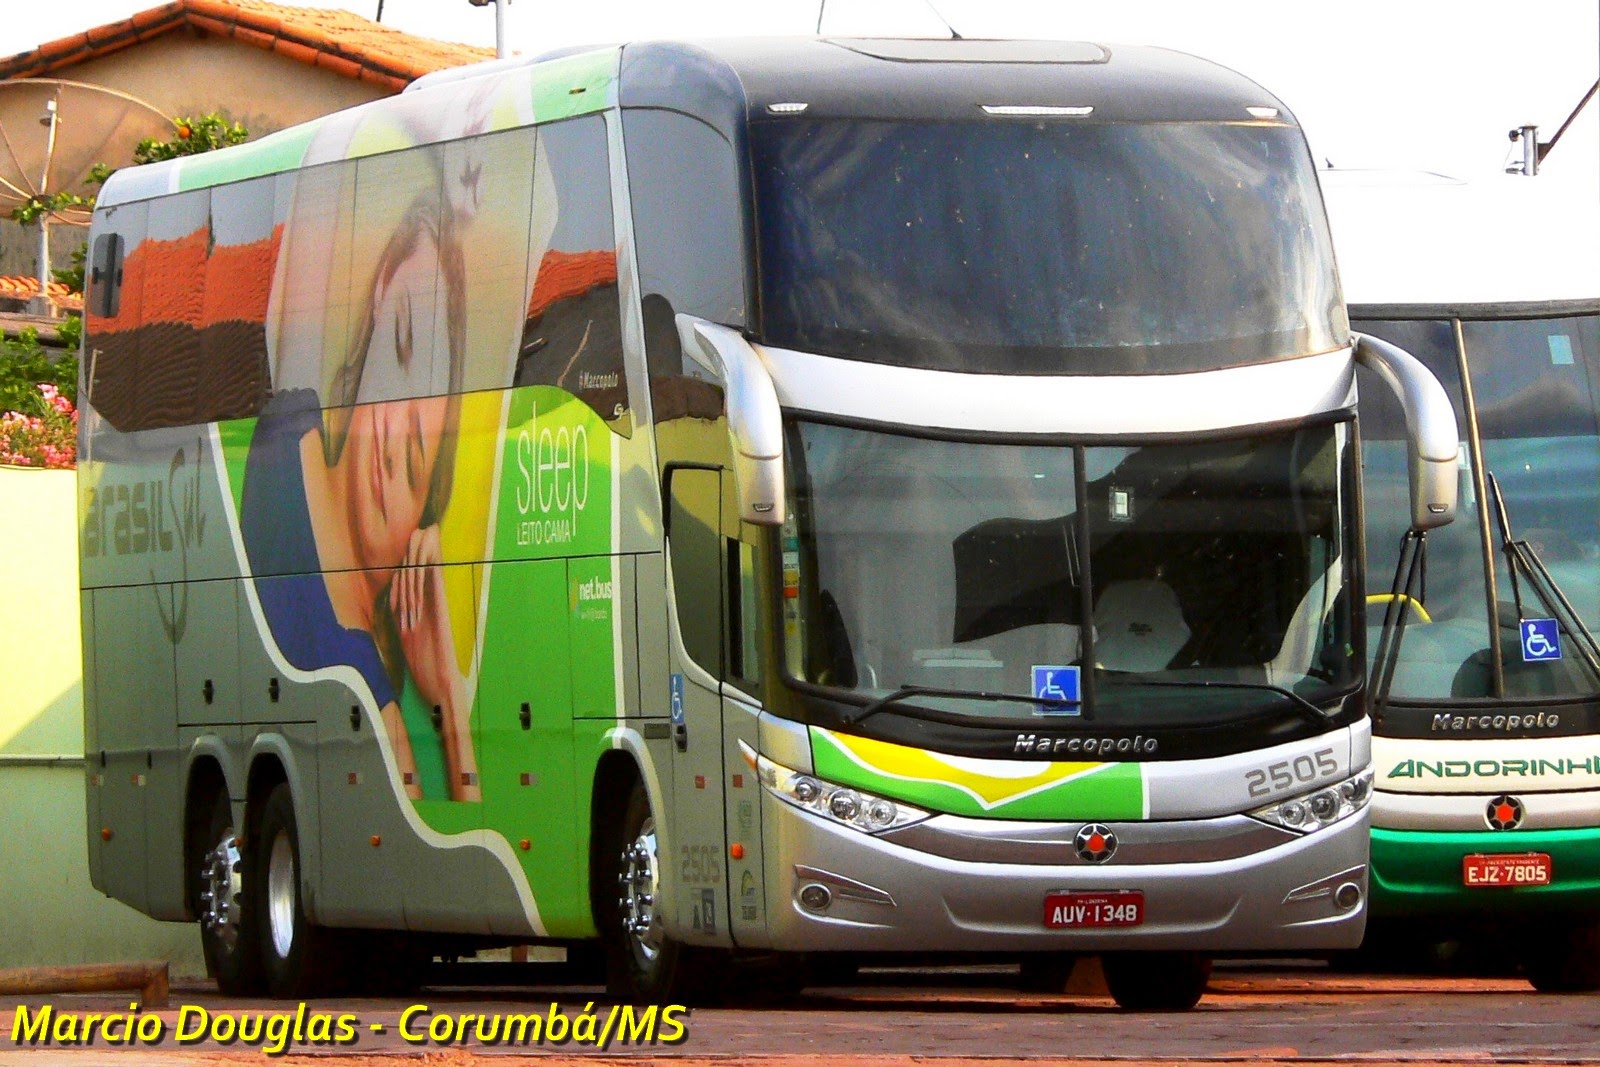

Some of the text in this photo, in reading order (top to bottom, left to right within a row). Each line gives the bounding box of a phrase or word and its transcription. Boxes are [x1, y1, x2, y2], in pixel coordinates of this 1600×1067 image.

[516, 400, 589, 537] sleep
[516, 519, 571, 546] LEITO CAMA
[579, 575, 612, 600] net.bus
[1431, 711, 1560, 731] Marcopolo
[1013, 733, 1158, 756] Marcopolo
[1245, 748, 1339, 799] 2505
[1387, 755, 1600, 779] ANDORINH
